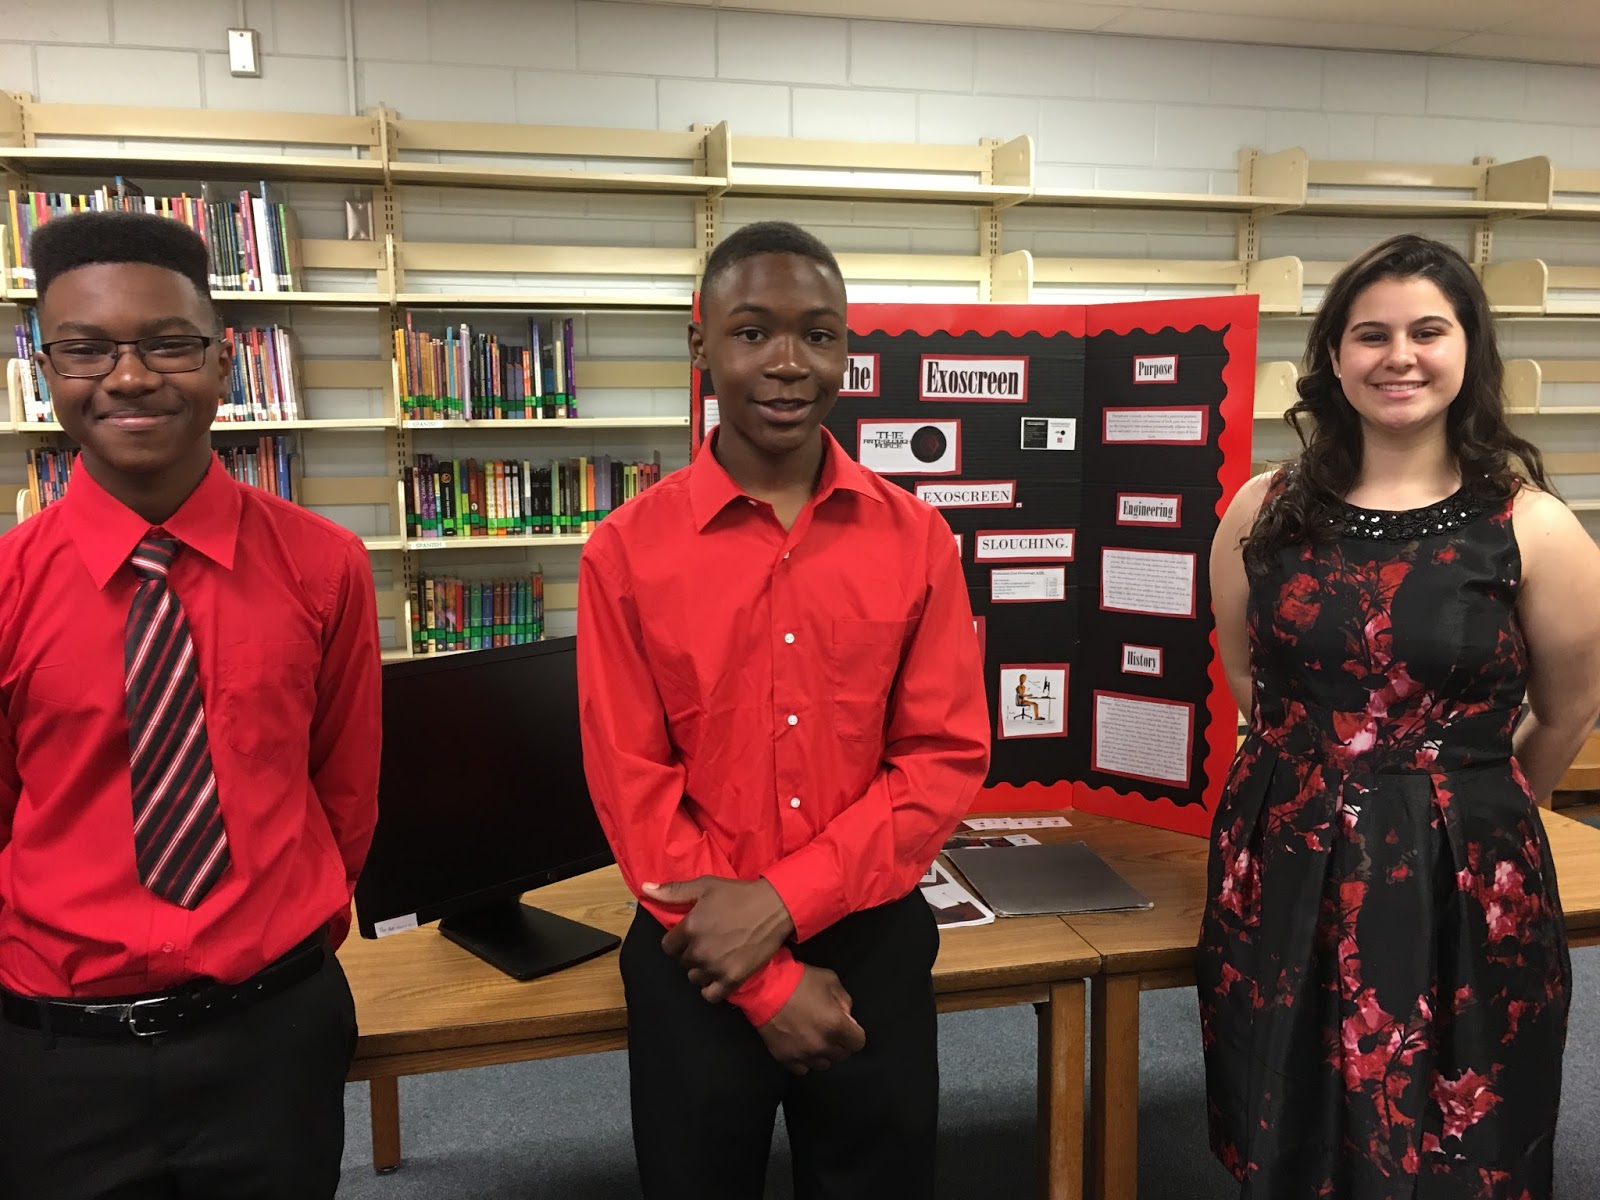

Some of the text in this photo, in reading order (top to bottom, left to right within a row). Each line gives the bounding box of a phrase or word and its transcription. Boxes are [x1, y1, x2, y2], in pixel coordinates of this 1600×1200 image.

[926, 361, 1019, 395] Exoscreen
[1138, 361, 1173, 379] Purpose
[876, 431, 904, 439] THE
[923, 490, 1010, 503] EXOSCREEN
[1123, 501, 1173, 521] Engineering
[982, 538, 1069, 550] SLOUCHING.
[1127, 651, 1157, 671] History
